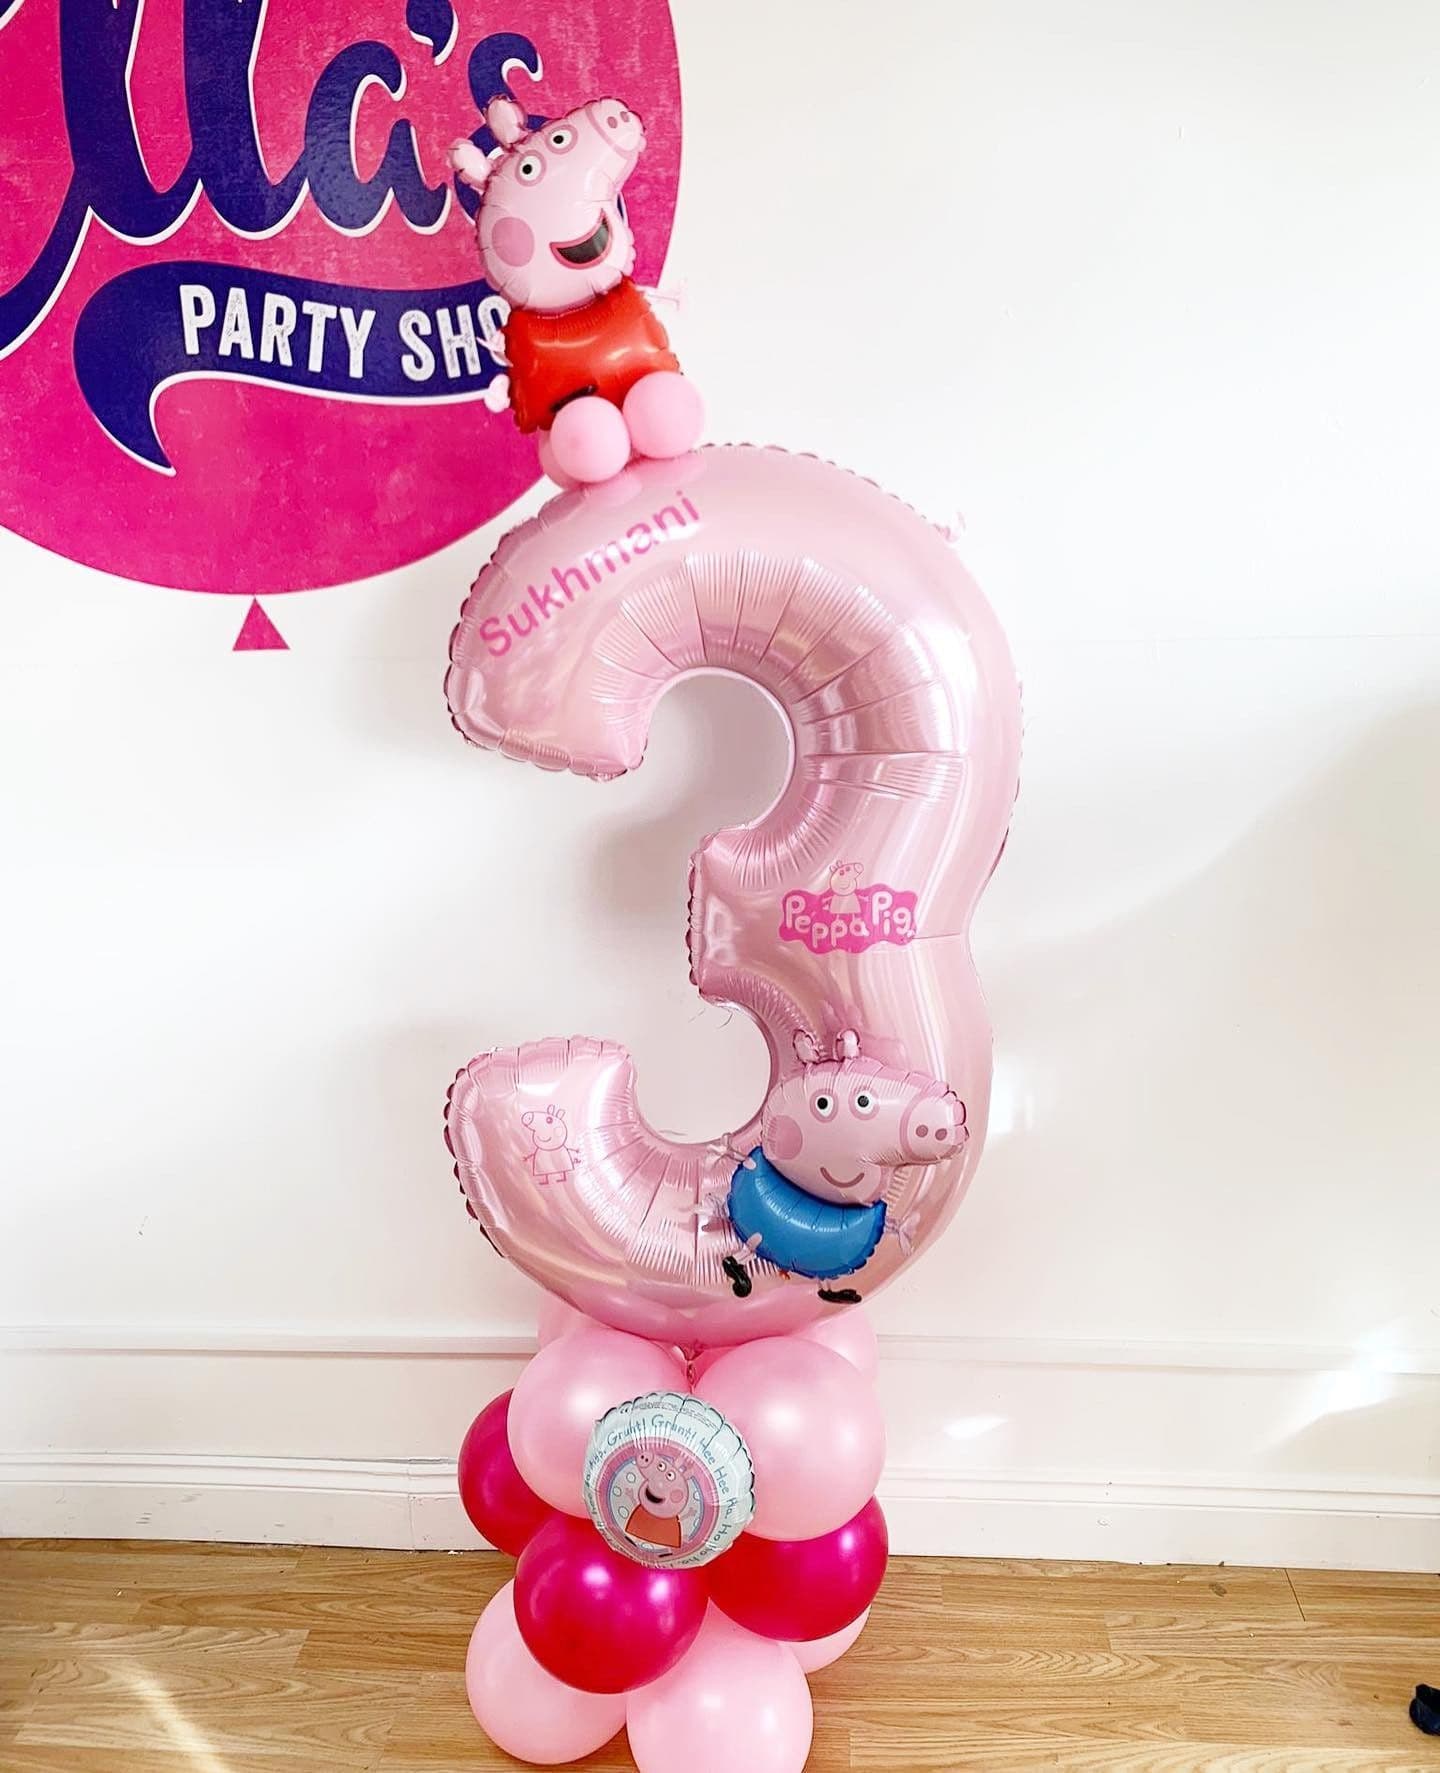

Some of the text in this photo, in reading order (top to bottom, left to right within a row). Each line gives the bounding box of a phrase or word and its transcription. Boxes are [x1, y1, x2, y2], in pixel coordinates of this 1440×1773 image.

[179, 283, 512, 381] PARTY SHO
[479, 490, 700, 657] Sukhmani
[785, 890, 912, 949] Peppa Pig
[713, 1465, 730, 1495] Hee
